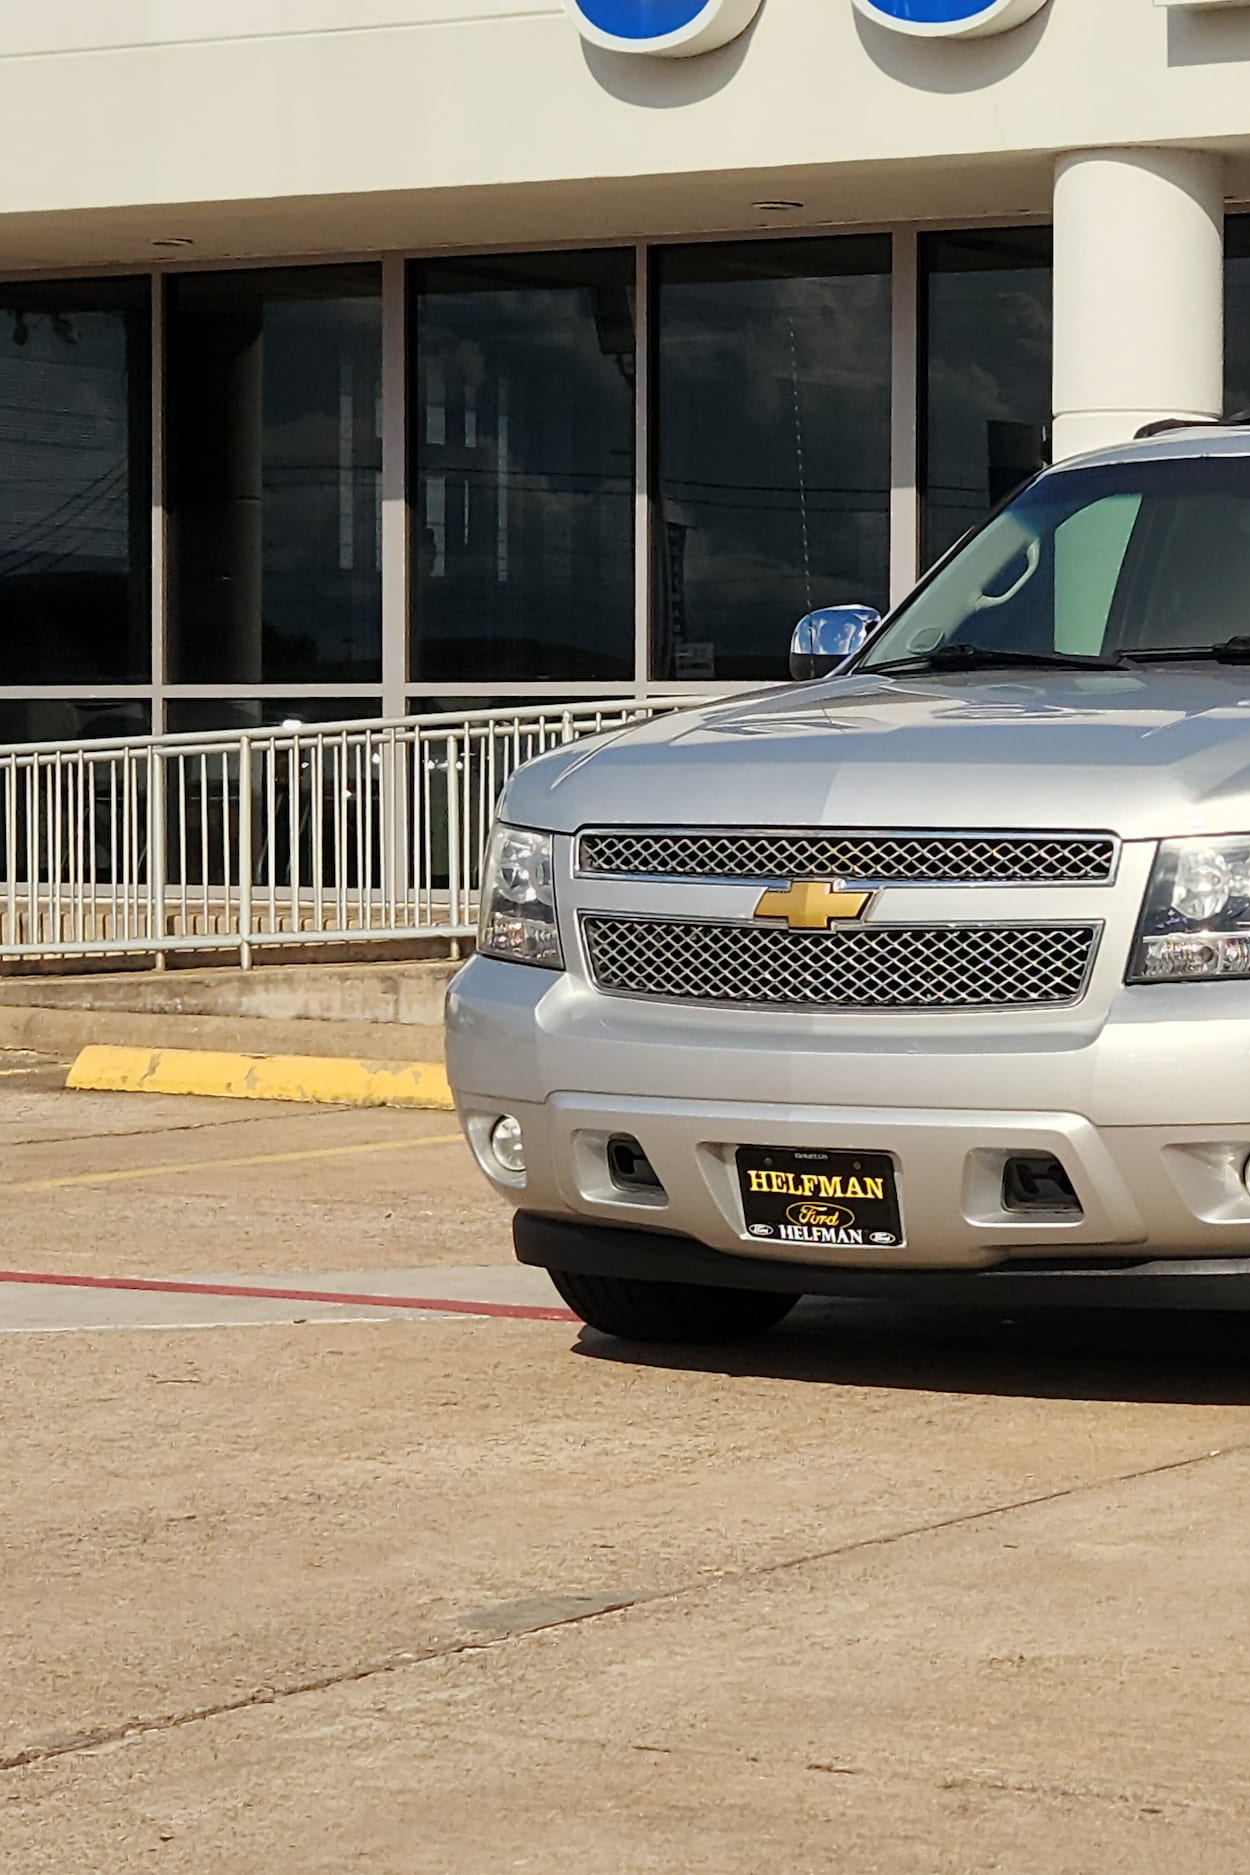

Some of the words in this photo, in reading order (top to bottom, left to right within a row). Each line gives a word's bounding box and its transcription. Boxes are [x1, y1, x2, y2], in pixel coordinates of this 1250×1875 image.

[747, 1170, 883, 1200] HELFMAN
[798, 1204, 840, 1226] Ford
[777, 1224, 863, 1244] HELFMAN
